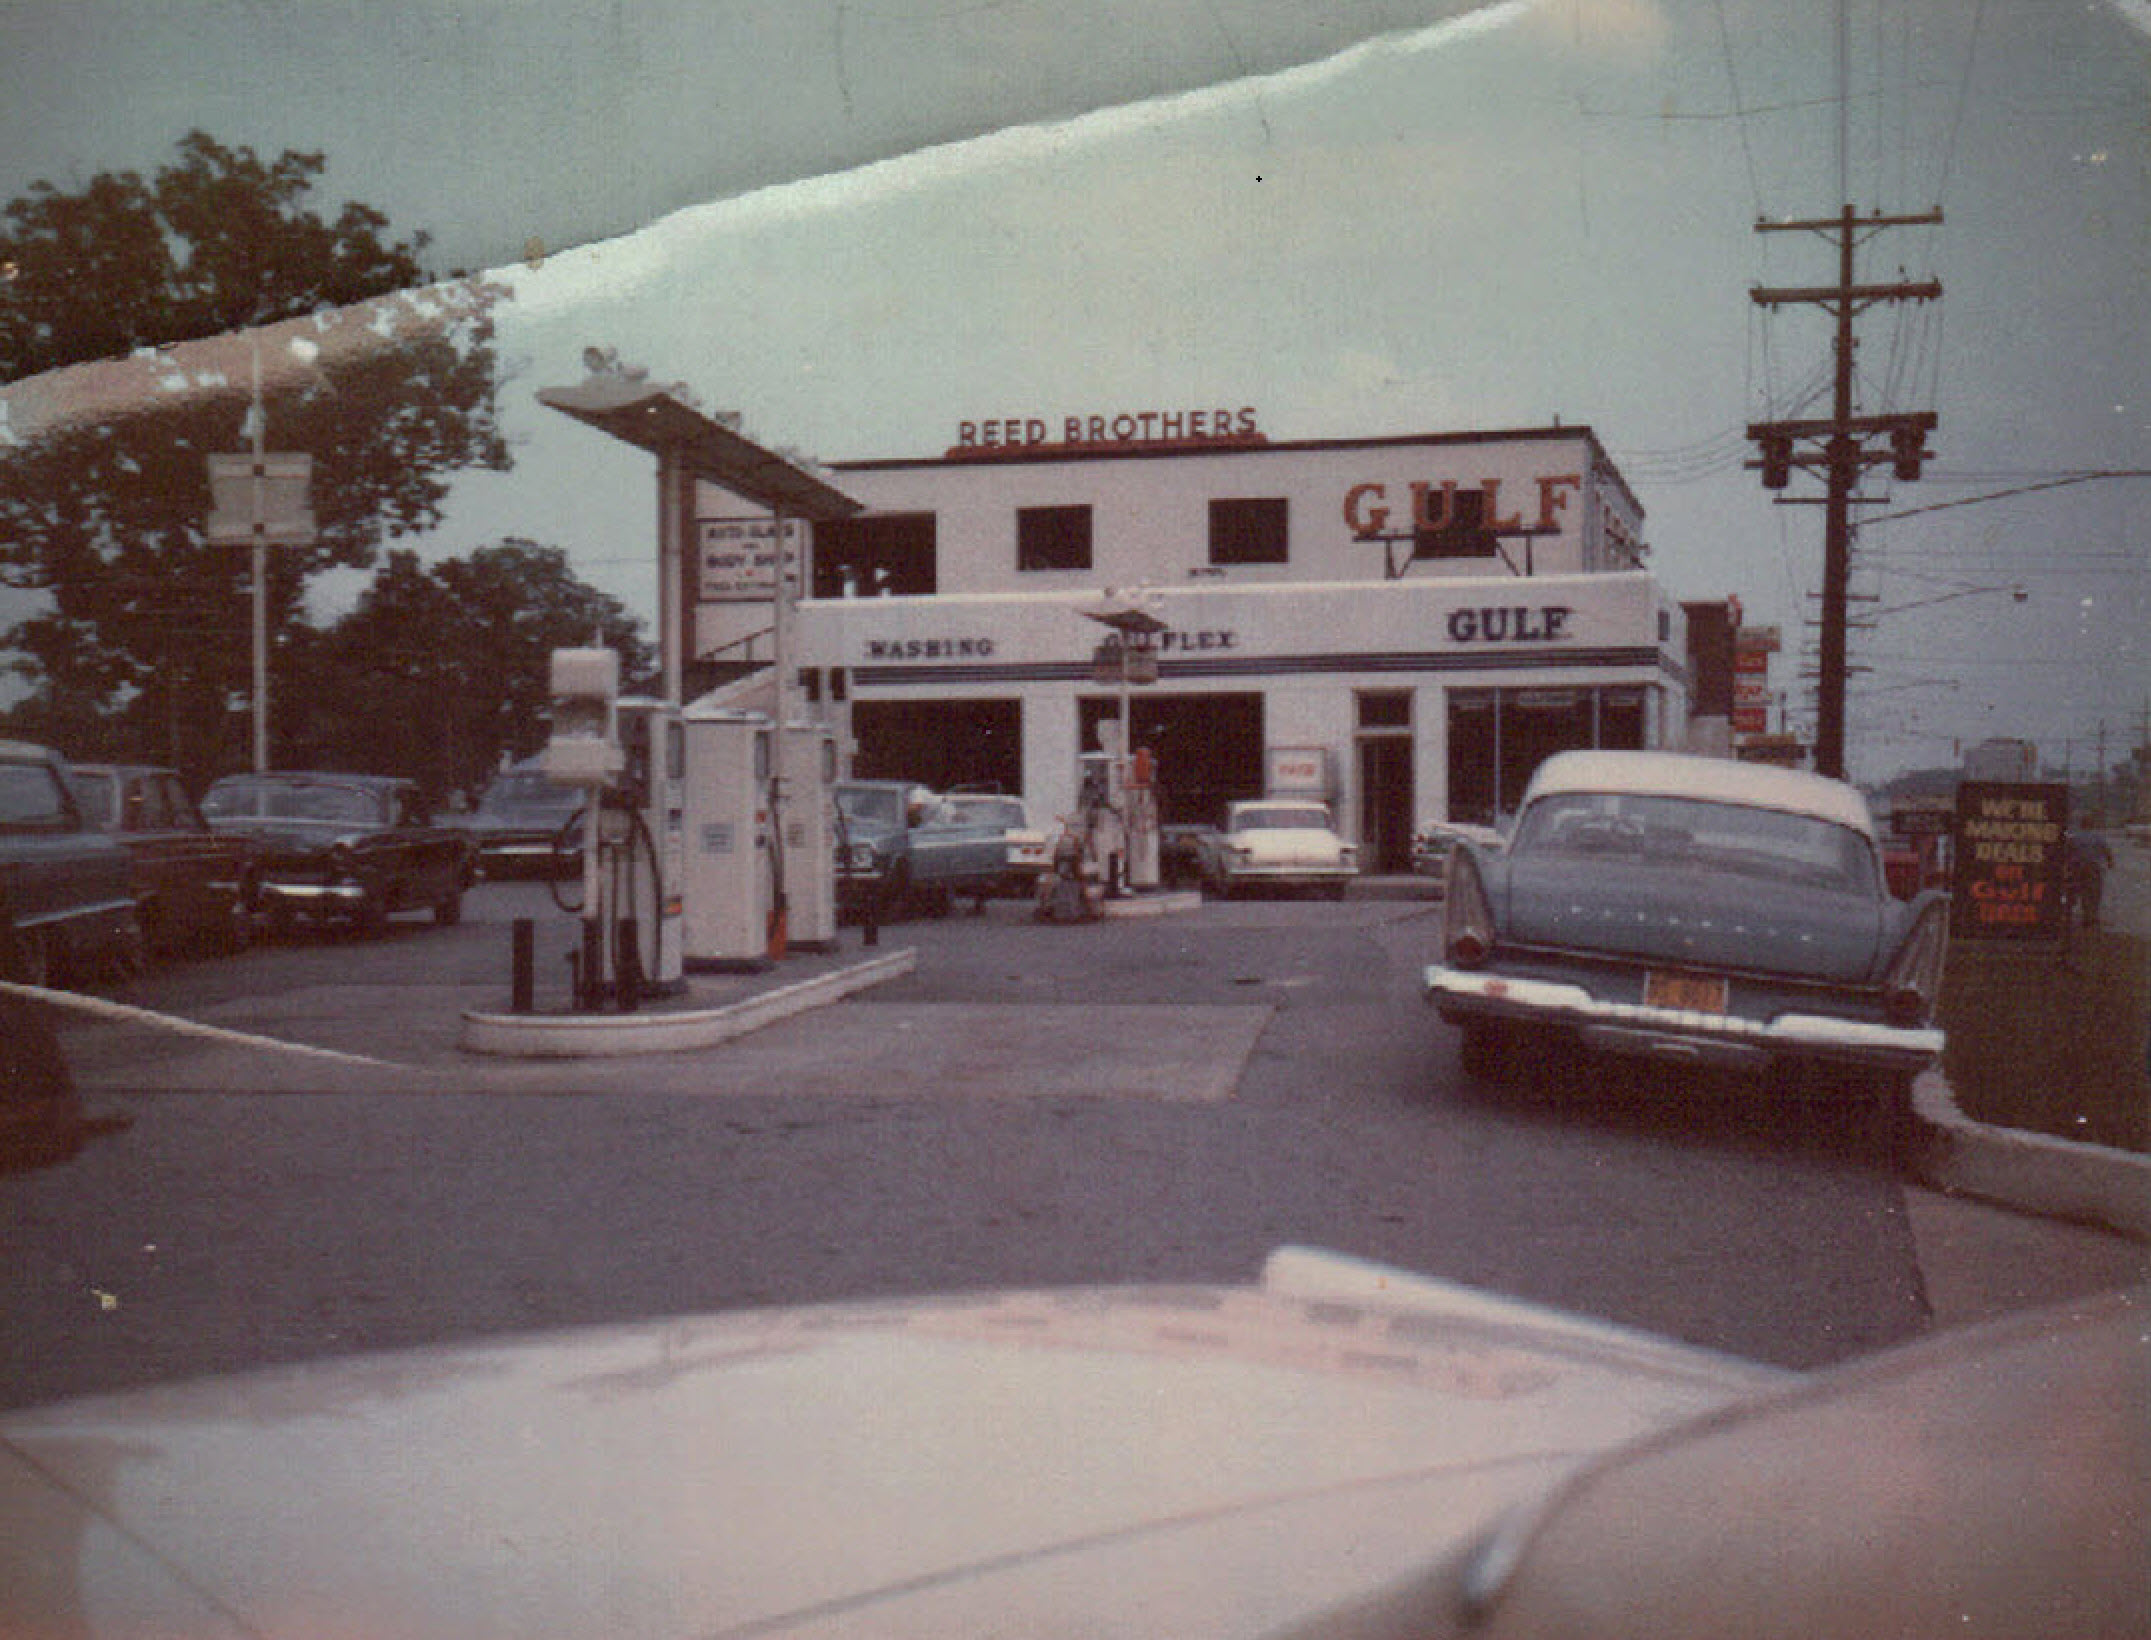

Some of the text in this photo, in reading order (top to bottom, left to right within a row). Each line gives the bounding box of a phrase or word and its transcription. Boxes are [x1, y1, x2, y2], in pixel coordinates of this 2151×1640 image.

[958, 407, 1257, 446] REED BROTHERS
[1343, 474, 1581, 536] GULF
[1447, 607, 1573, 642] GULF
[863, 637, 994, 660] WASHING
